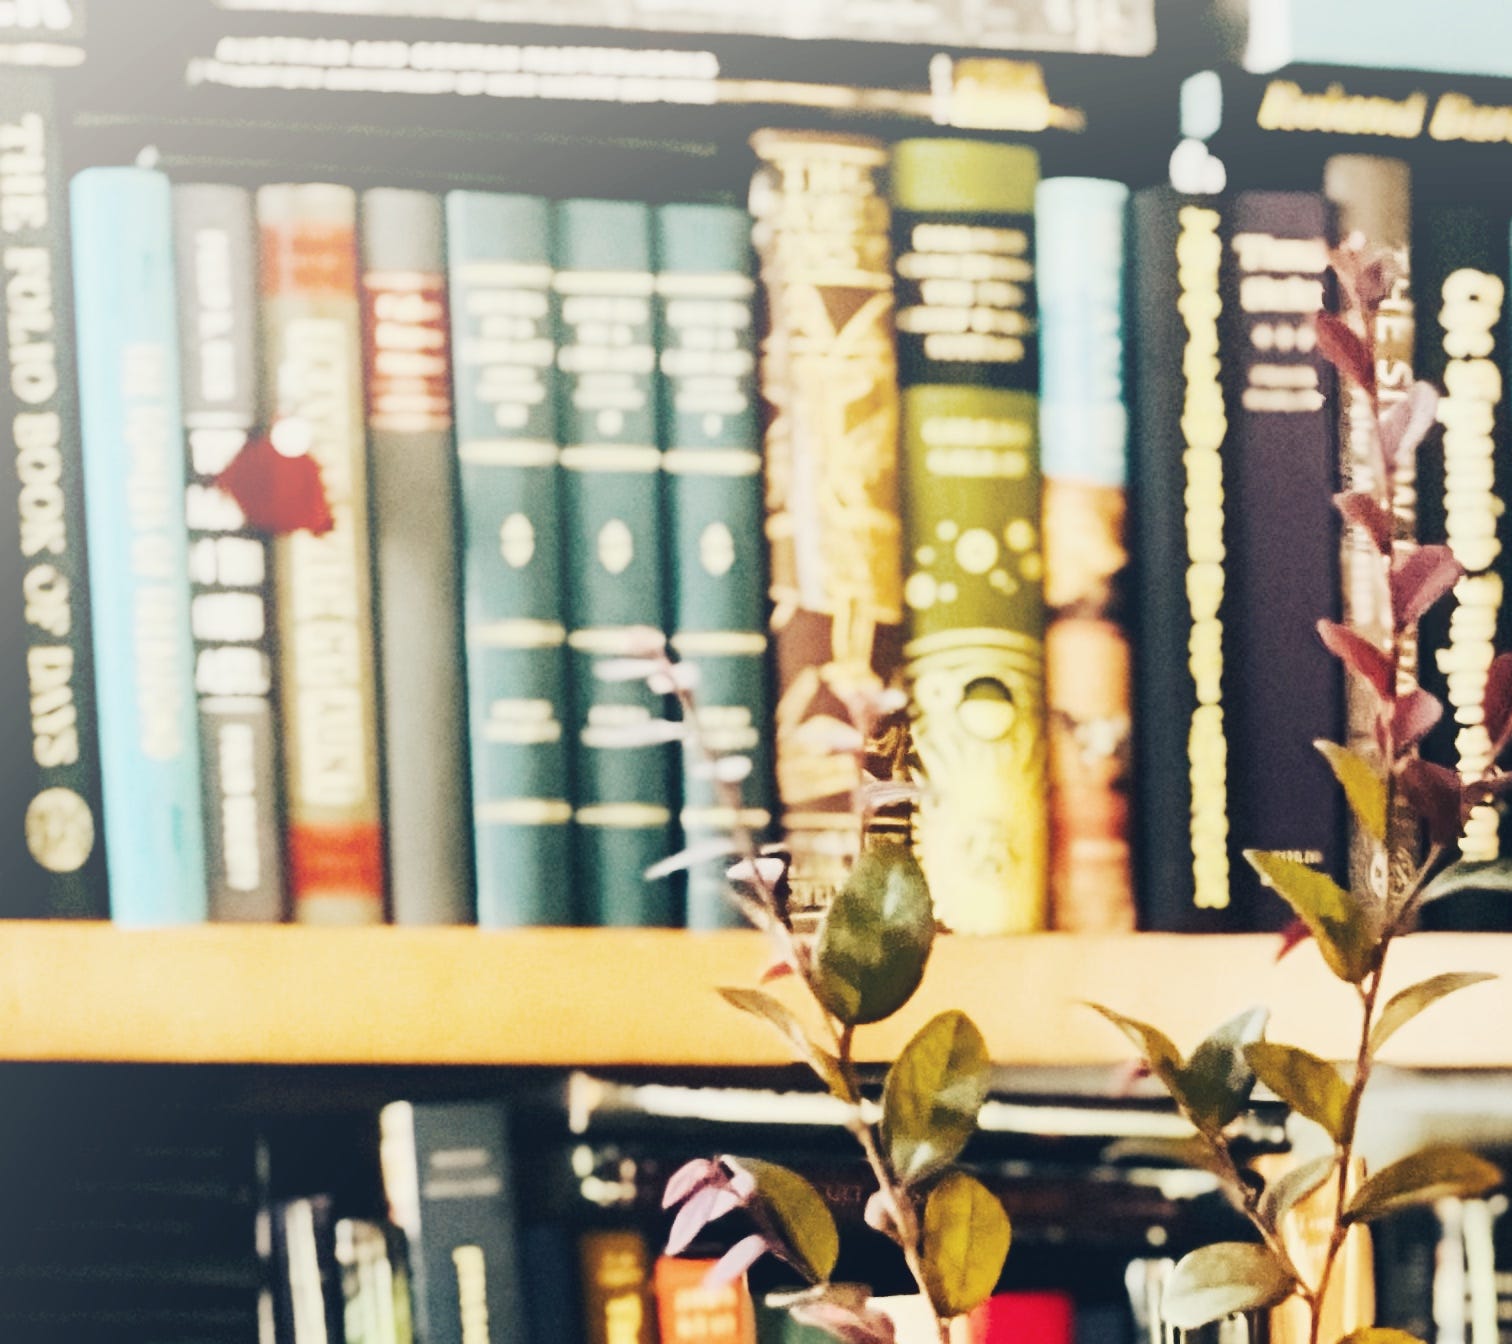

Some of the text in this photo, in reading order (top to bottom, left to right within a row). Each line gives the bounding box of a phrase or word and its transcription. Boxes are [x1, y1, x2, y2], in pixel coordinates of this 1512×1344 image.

[11, 413, 68, 558] BOOK
[22, 562, 72, 640] OF
[27, 646, 81, 769] DAYS
